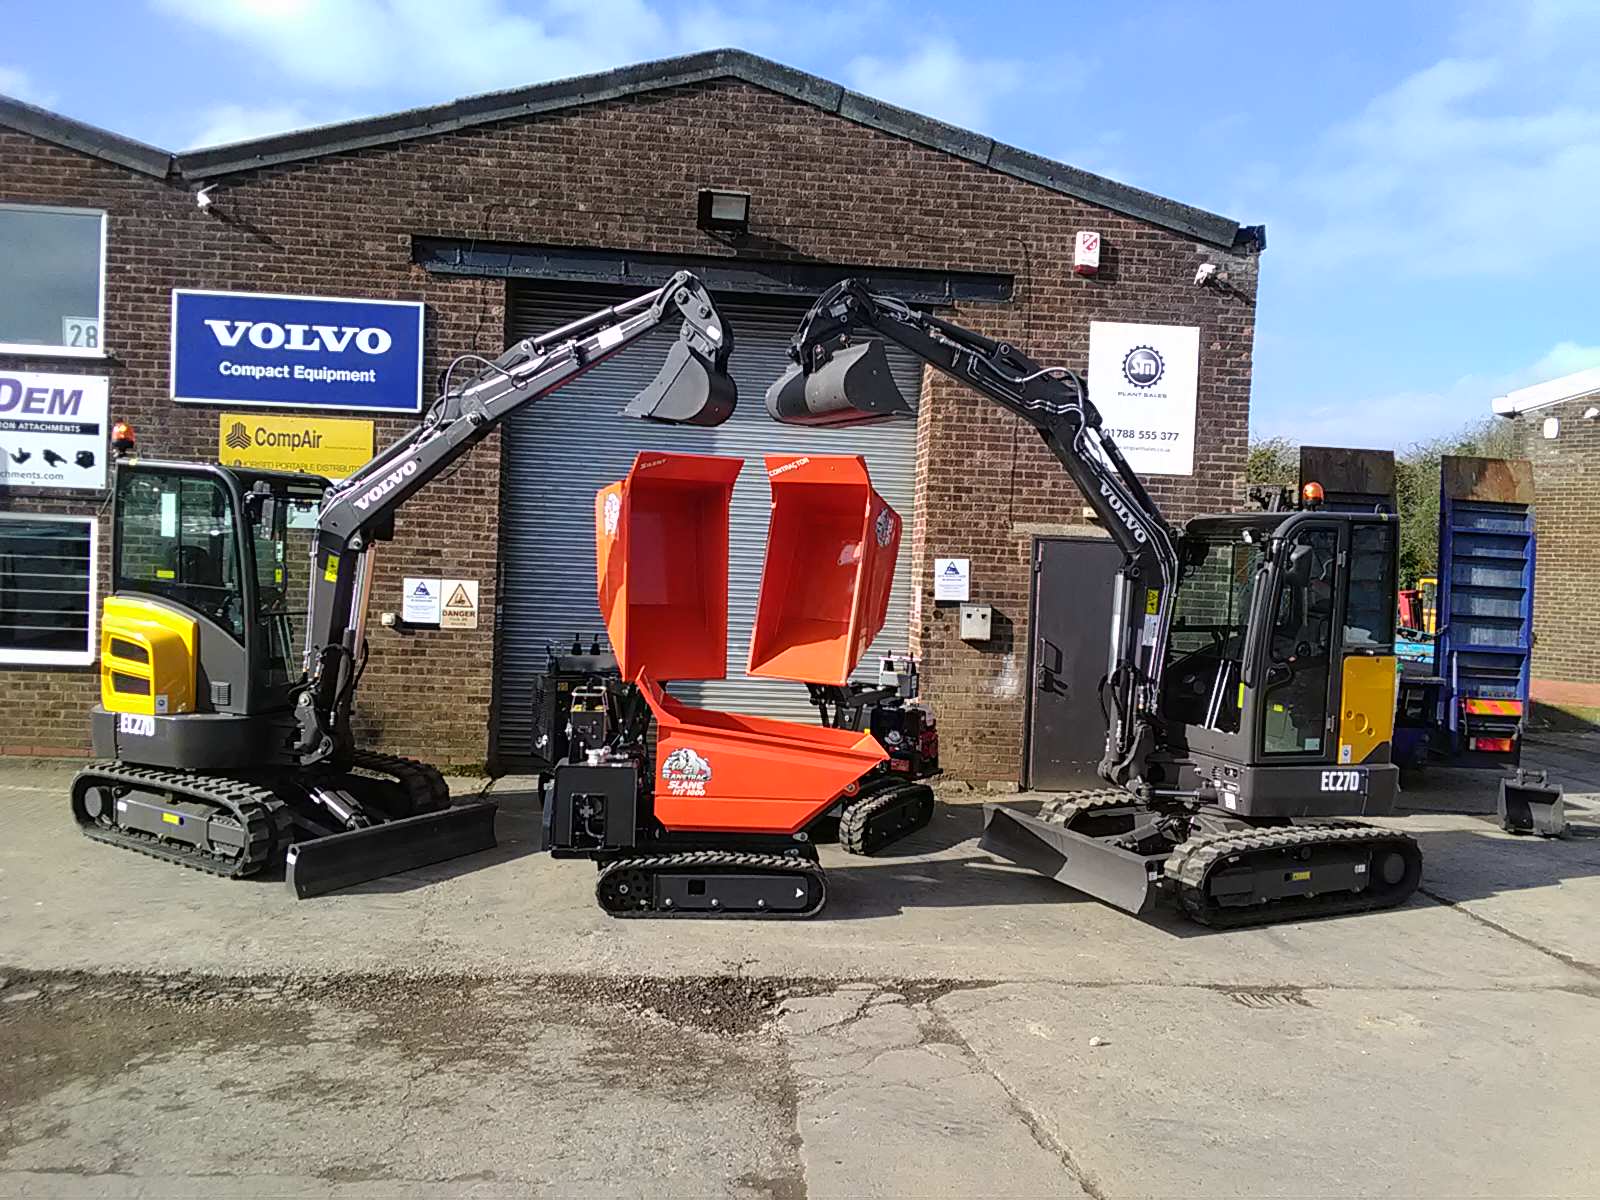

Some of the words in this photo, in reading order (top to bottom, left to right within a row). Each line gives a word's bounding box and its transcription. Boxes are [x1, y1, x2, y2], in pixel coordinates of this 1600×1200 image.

[70, 324, 98, 348] 28
[204, 319, 392, 355] VOLVO
[219, 361, 290, 379] Compact
[294, 365, 377, 383] Equipment
[18, 421, 81, 433] ATTACHMENTS
[1104, 428, 1135, 439] 01788
[1138, 430, 1157, 440] 555
[1160, 432, 1180, 441] 377
[254, 427, 323, 452] CompAir
[768, 457, 810, 477] CONTRACTOR
[353, 460, 417, 510] VOLVO
[1100, 481, 1147, 543] VOLVO
